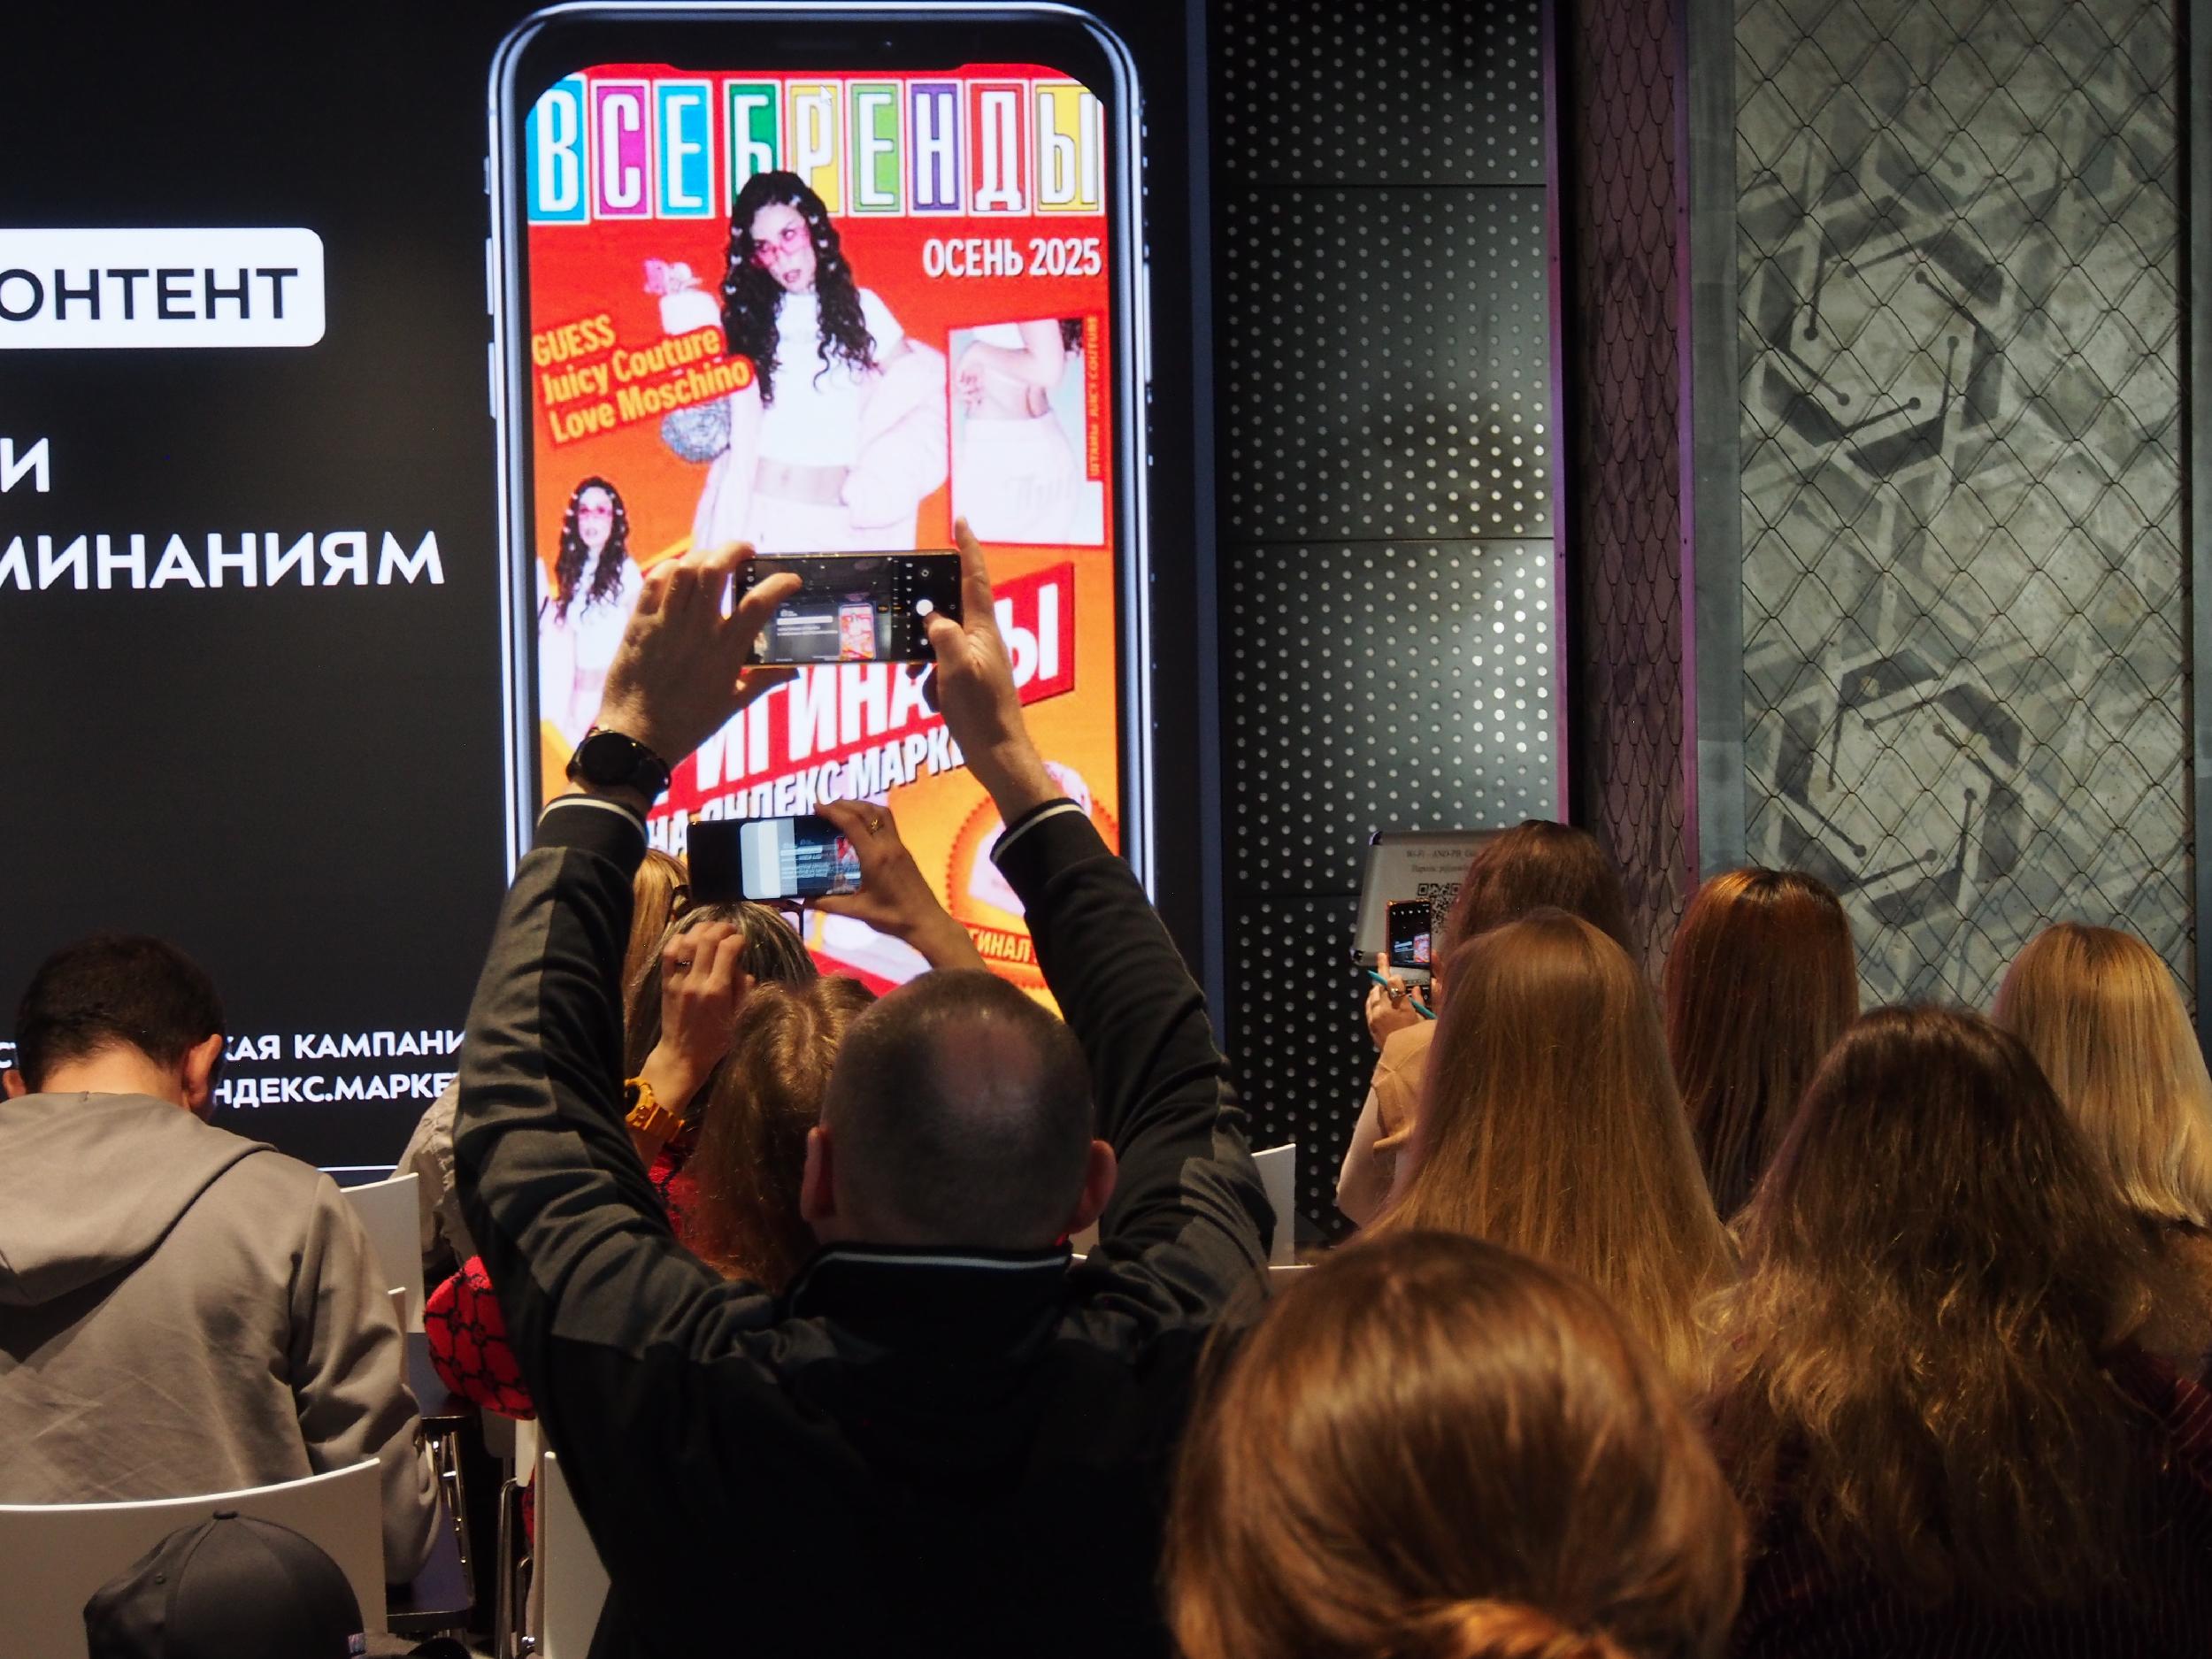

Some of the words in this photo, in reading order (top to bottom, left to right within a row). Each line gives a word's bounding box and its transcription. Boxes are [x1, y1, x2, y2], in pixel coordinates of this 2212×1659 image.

[534, 88, 703, 212] ВСЕ
[923, 237, 1024, 276] ОСЕНЬ
[1029, 237, 1102, 276] 2025
[0, 268, 299, 321] ОНТЕНТ
[531, 313, 617, 366] GUESS
[541, 363, 609, 405] Juicy
[611, 328, 720, 383] Couture
[549, 402, 617, 443] Love
[616, 359, 750, 422] Moschino
[848, 724, 965, 801] МАРК
[214, 1071, 459, 1109] НДЕКС.МАРКЕ
